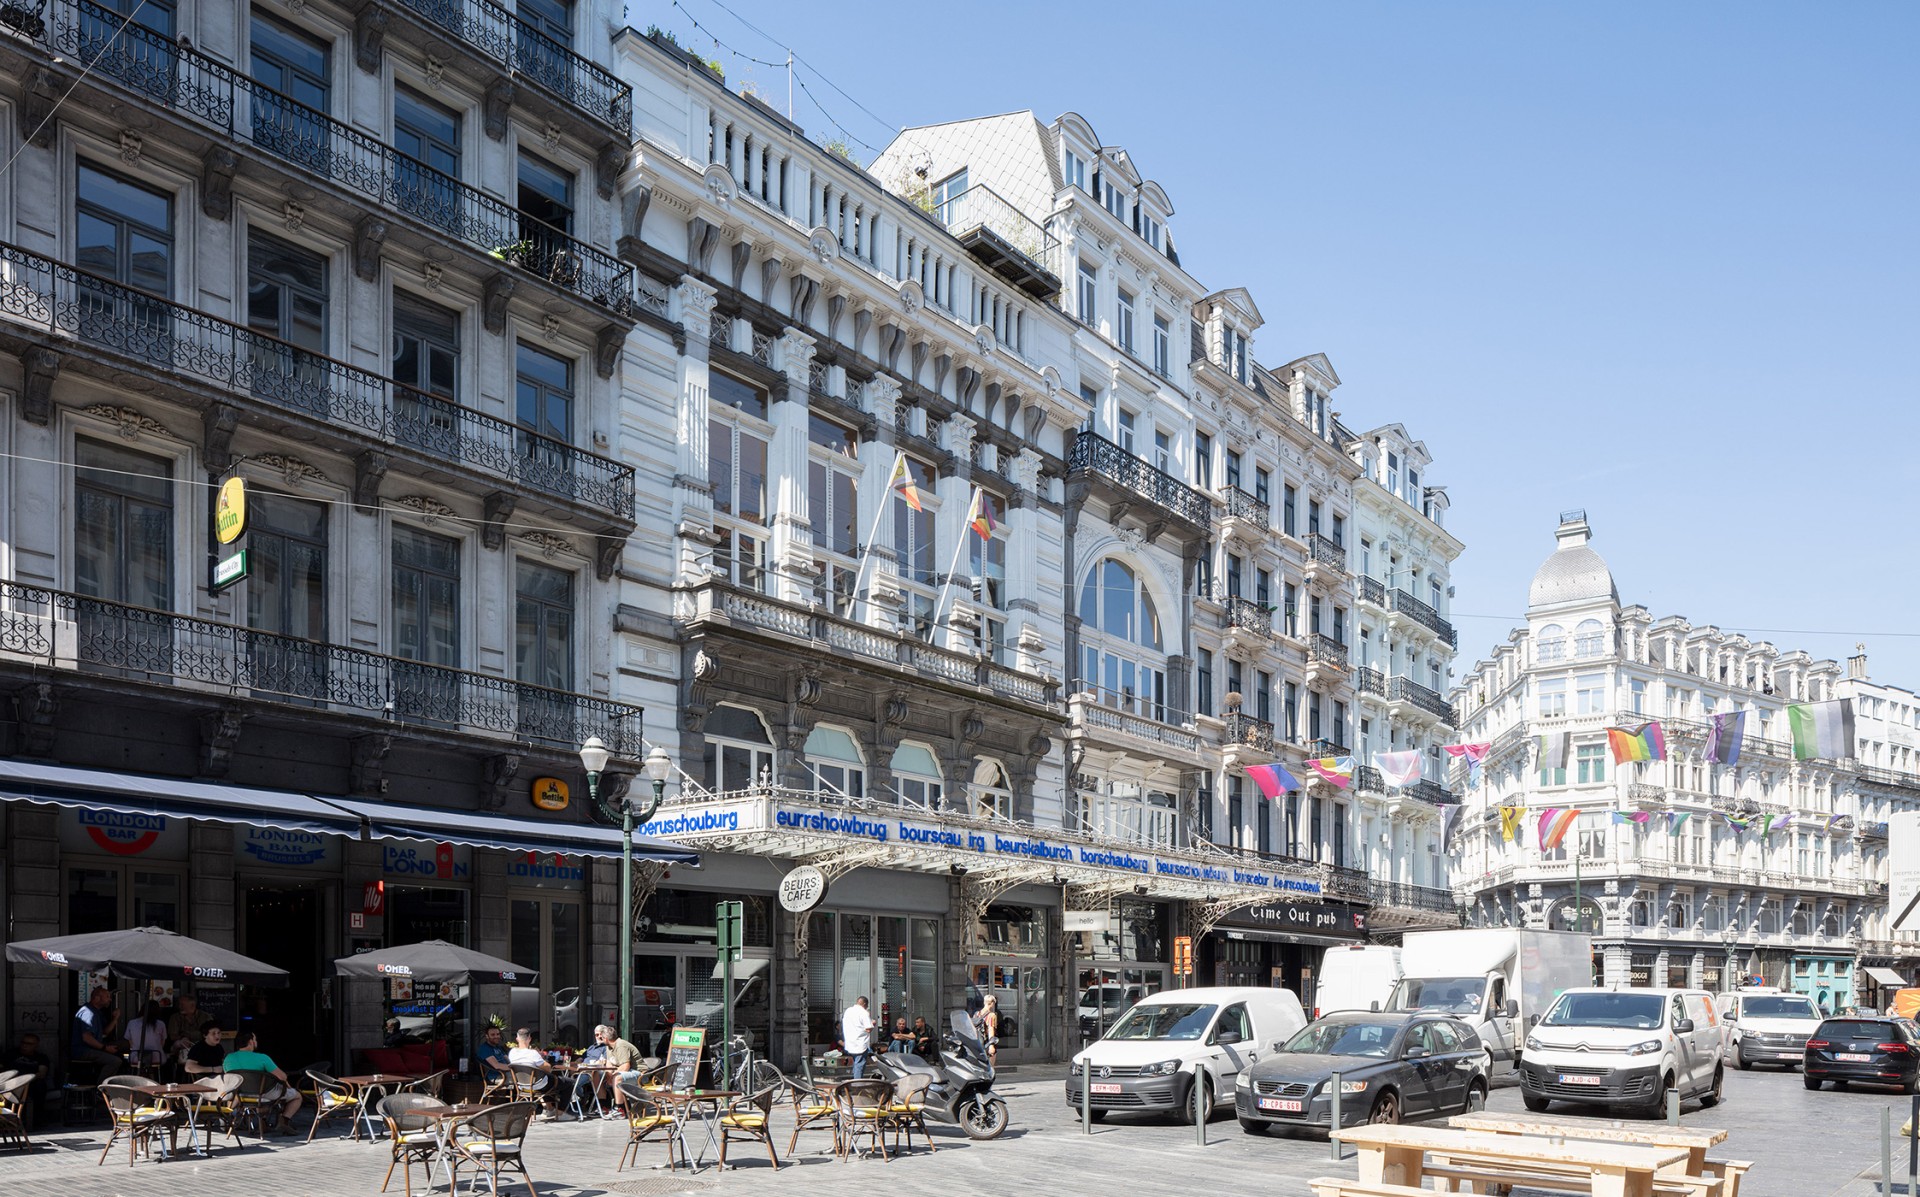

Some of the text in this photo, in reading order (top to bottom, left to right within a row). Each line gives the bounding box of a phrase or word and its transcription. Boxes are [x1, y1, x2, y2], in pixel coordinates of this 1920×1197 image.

[83, 810, 161, 829] LONDON
[108, 828, 137, 840] BAR
[249, 828, 323, 845] LONDON
[269, 842, 303, 853] BAR
[389, 847, 417, 860] BAR
[260, 851, 312, 863] BRUSSELS
[507, 862, 584, 880] LONDON
[784, 876, 817, 892] BEURS
[364, 886, 382, 913] illy
[787, 888, 812, 902] CAFE
[353, 914, 362, 926] H
[1079, 916, 1095, 925] hello
[1288, 907, 1310, 923] Out
[1316, 911, 1337, 927] pub
